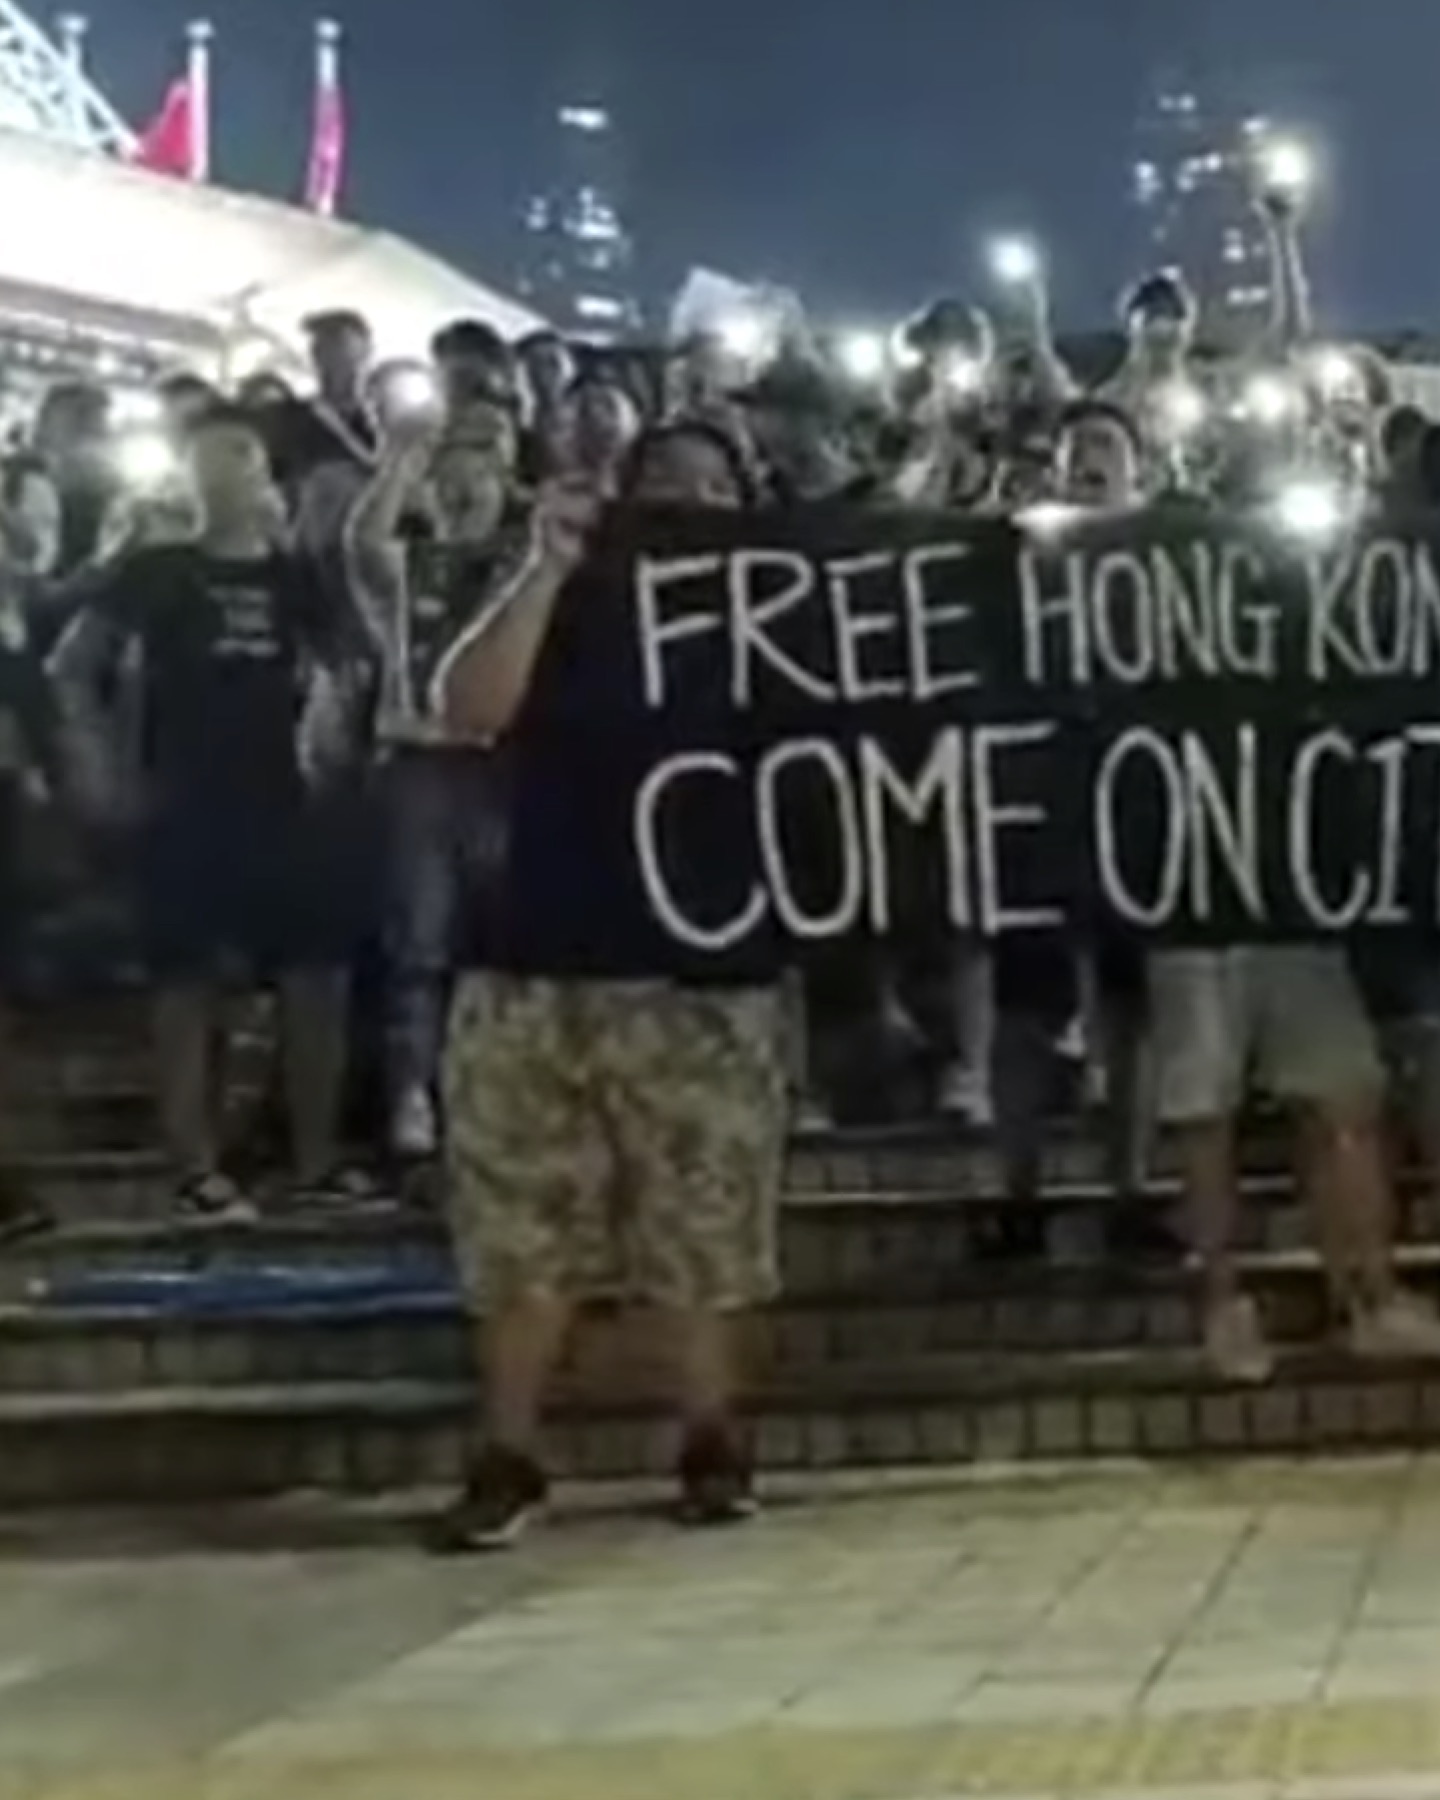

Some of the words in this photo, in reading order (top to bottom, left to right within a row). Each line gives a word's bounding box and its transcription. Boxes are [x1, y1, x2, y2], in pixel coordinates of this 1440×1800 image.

[634, 542, 980, 708] FREE
[1017, 539, 1280, 685] HONG
[634, 721, 1066, 950] COME
[1095, 723, 1269, 928] ON
